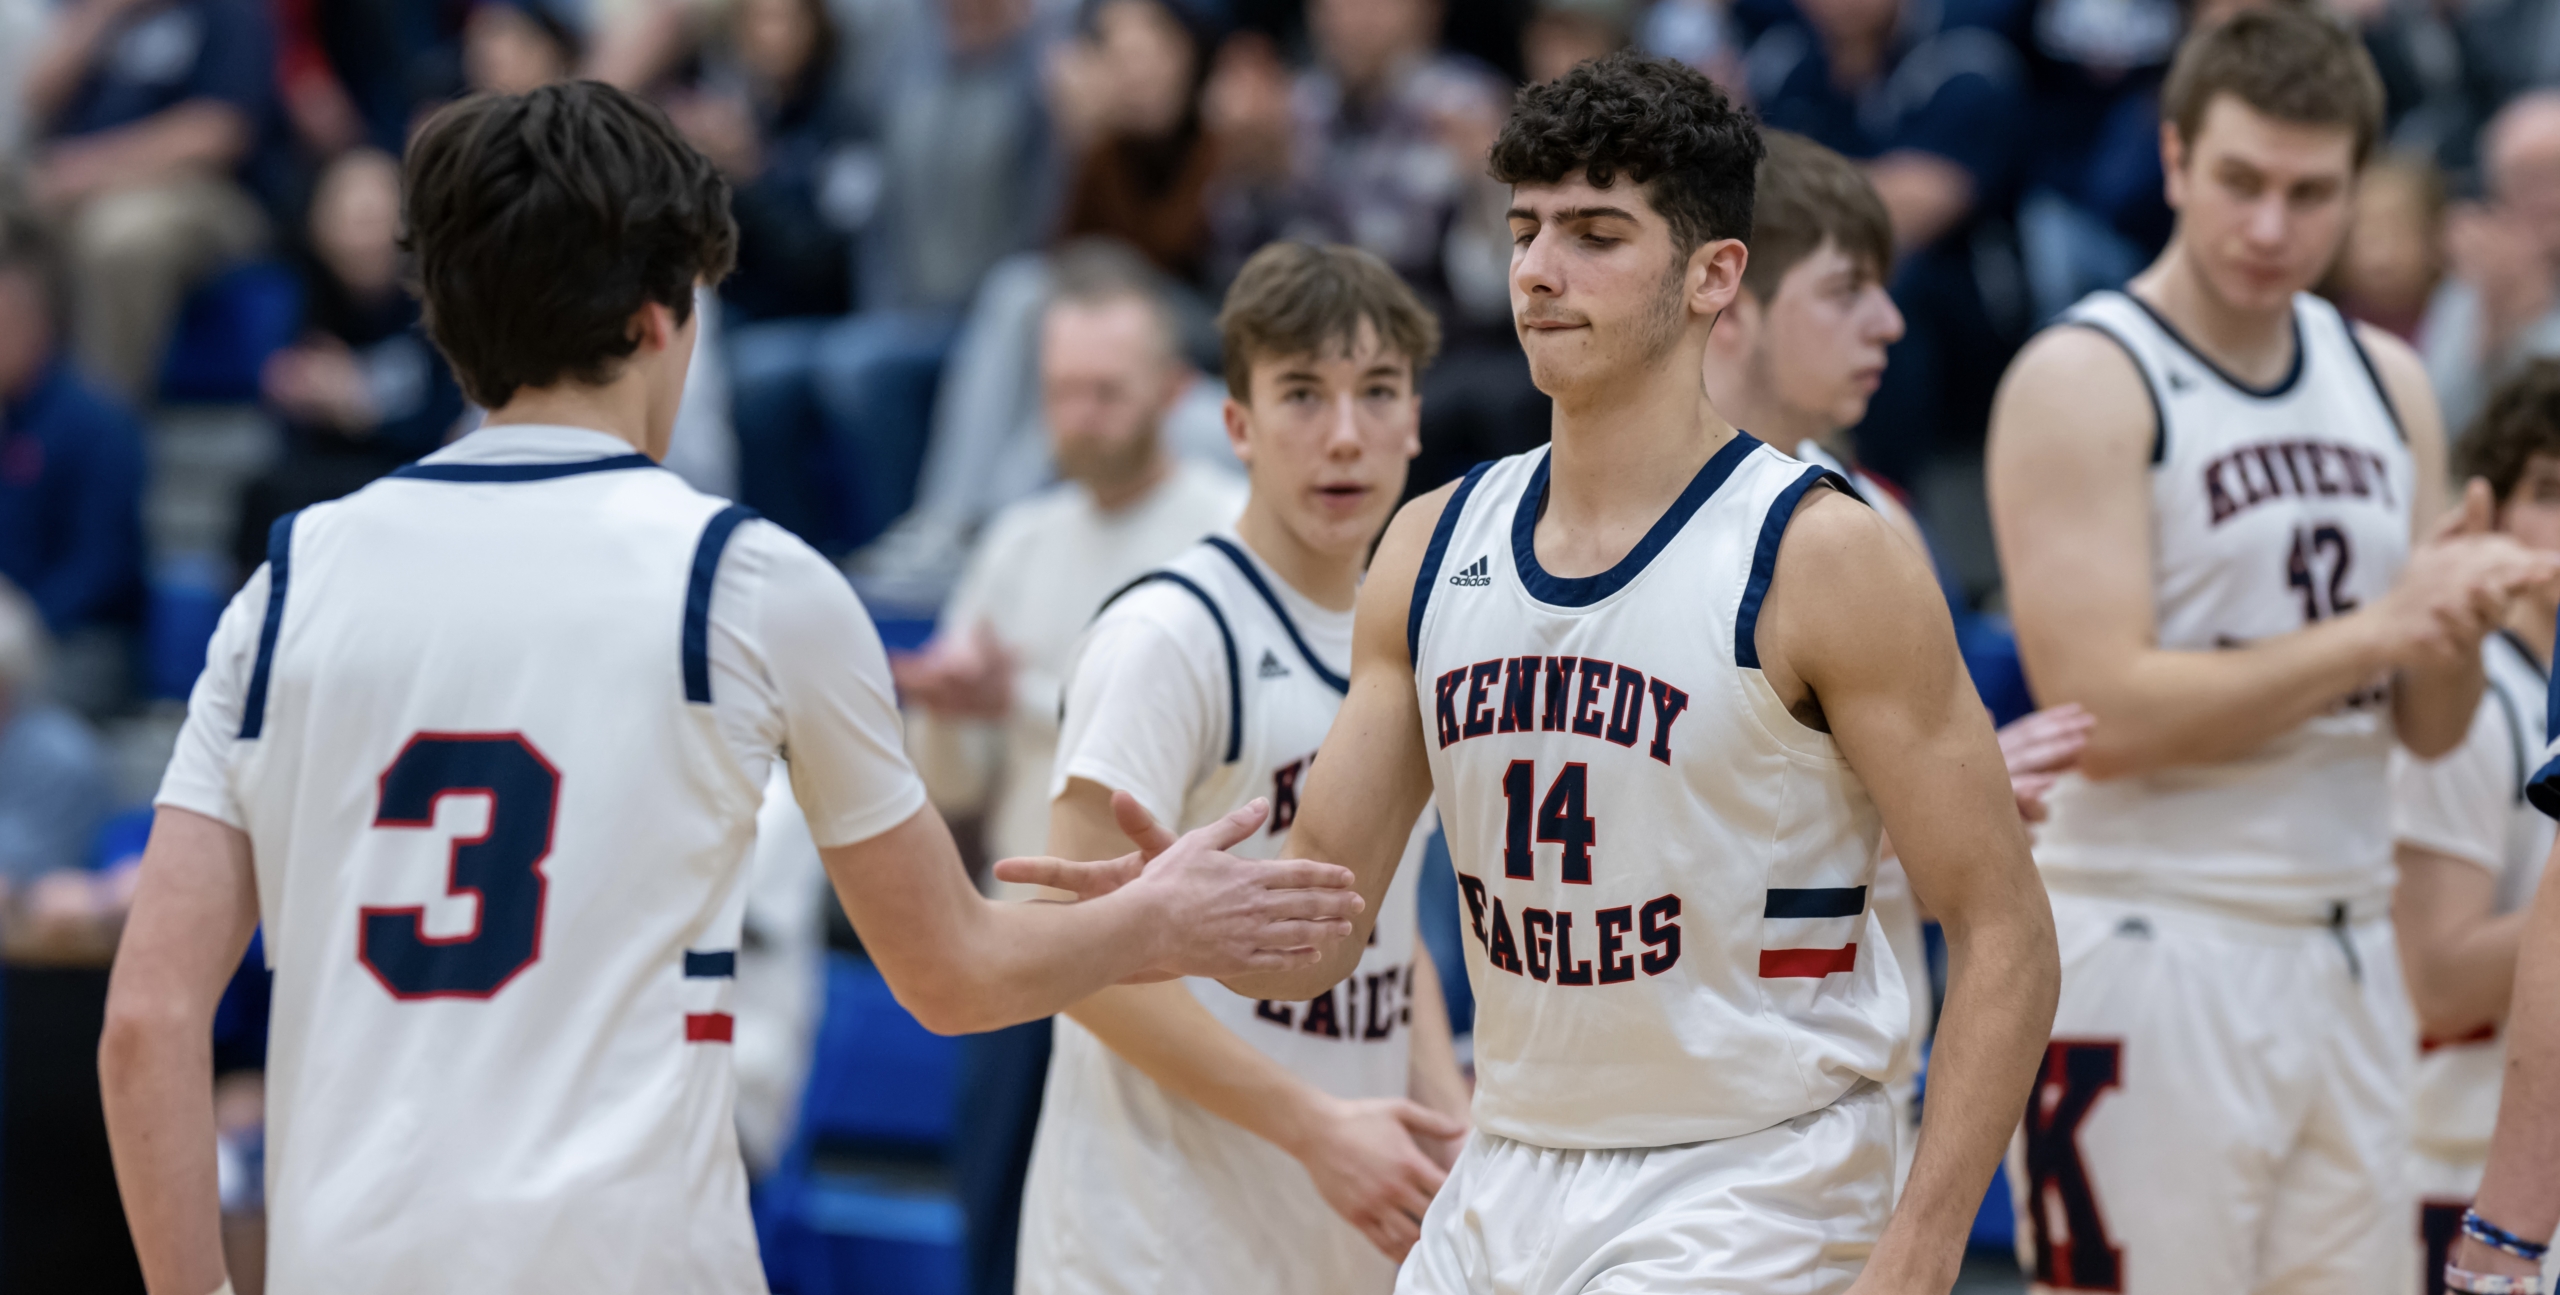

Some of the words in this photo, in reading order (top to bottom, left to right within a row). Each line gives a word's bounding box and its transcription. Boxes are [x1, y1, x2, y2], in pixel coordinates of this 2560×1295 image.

[1449, 575, 1491, 587] adidas
[2288, 524, 2358, 622] 42
[1435, 656, 1689, 765] KENNEDY
[357, 730, 563, 1001] 3
[1502, 759, 1595, 884] 14
[1458, 870, 1682, 986] EAGLES
[2025, 1039, 2126, 1292] K
